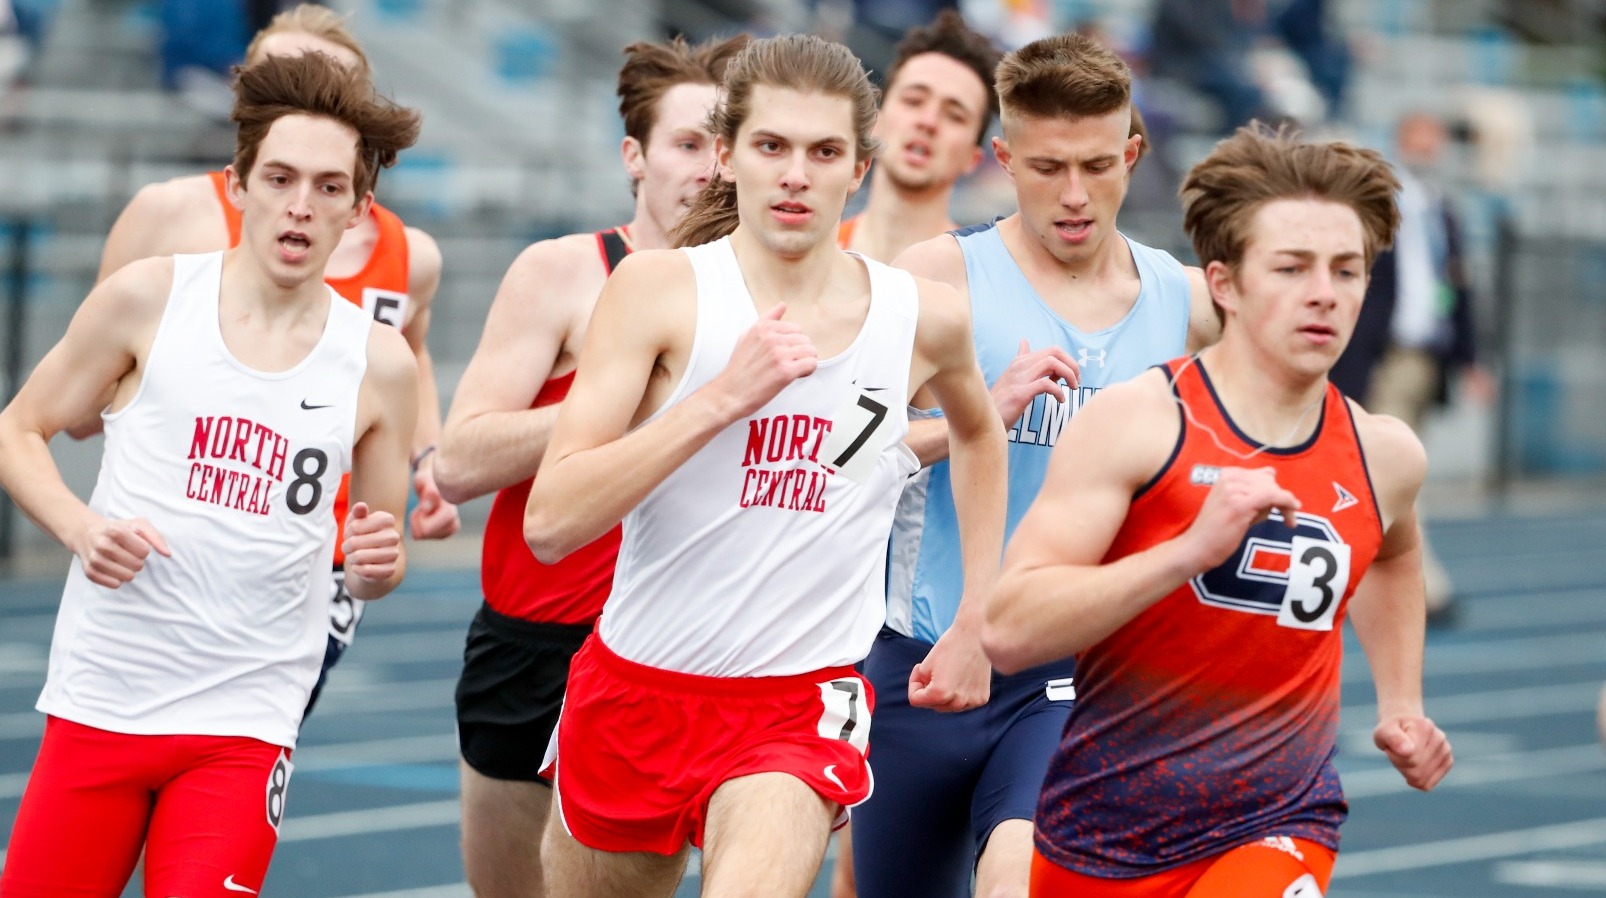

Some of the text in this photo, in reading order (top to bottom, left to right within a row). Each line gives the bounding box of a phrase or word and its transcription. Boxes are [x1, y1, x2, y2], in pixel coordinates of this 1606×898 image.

[187, 416, 289, 482] NORTH
[741, 414, 835, 475] NORT
[832, 394, 889, 468] 7
[186, 462, 273, 516] CENTRAL
[286, 447, 328, 515] 8
[740, 468, 827, 513] CENTRAL
[331, 578, 354, 633] 5
[1291, 546, 1338, 623] 3
[830, 681, 858, 742] 7
[268, 760, 286, 828] 8
